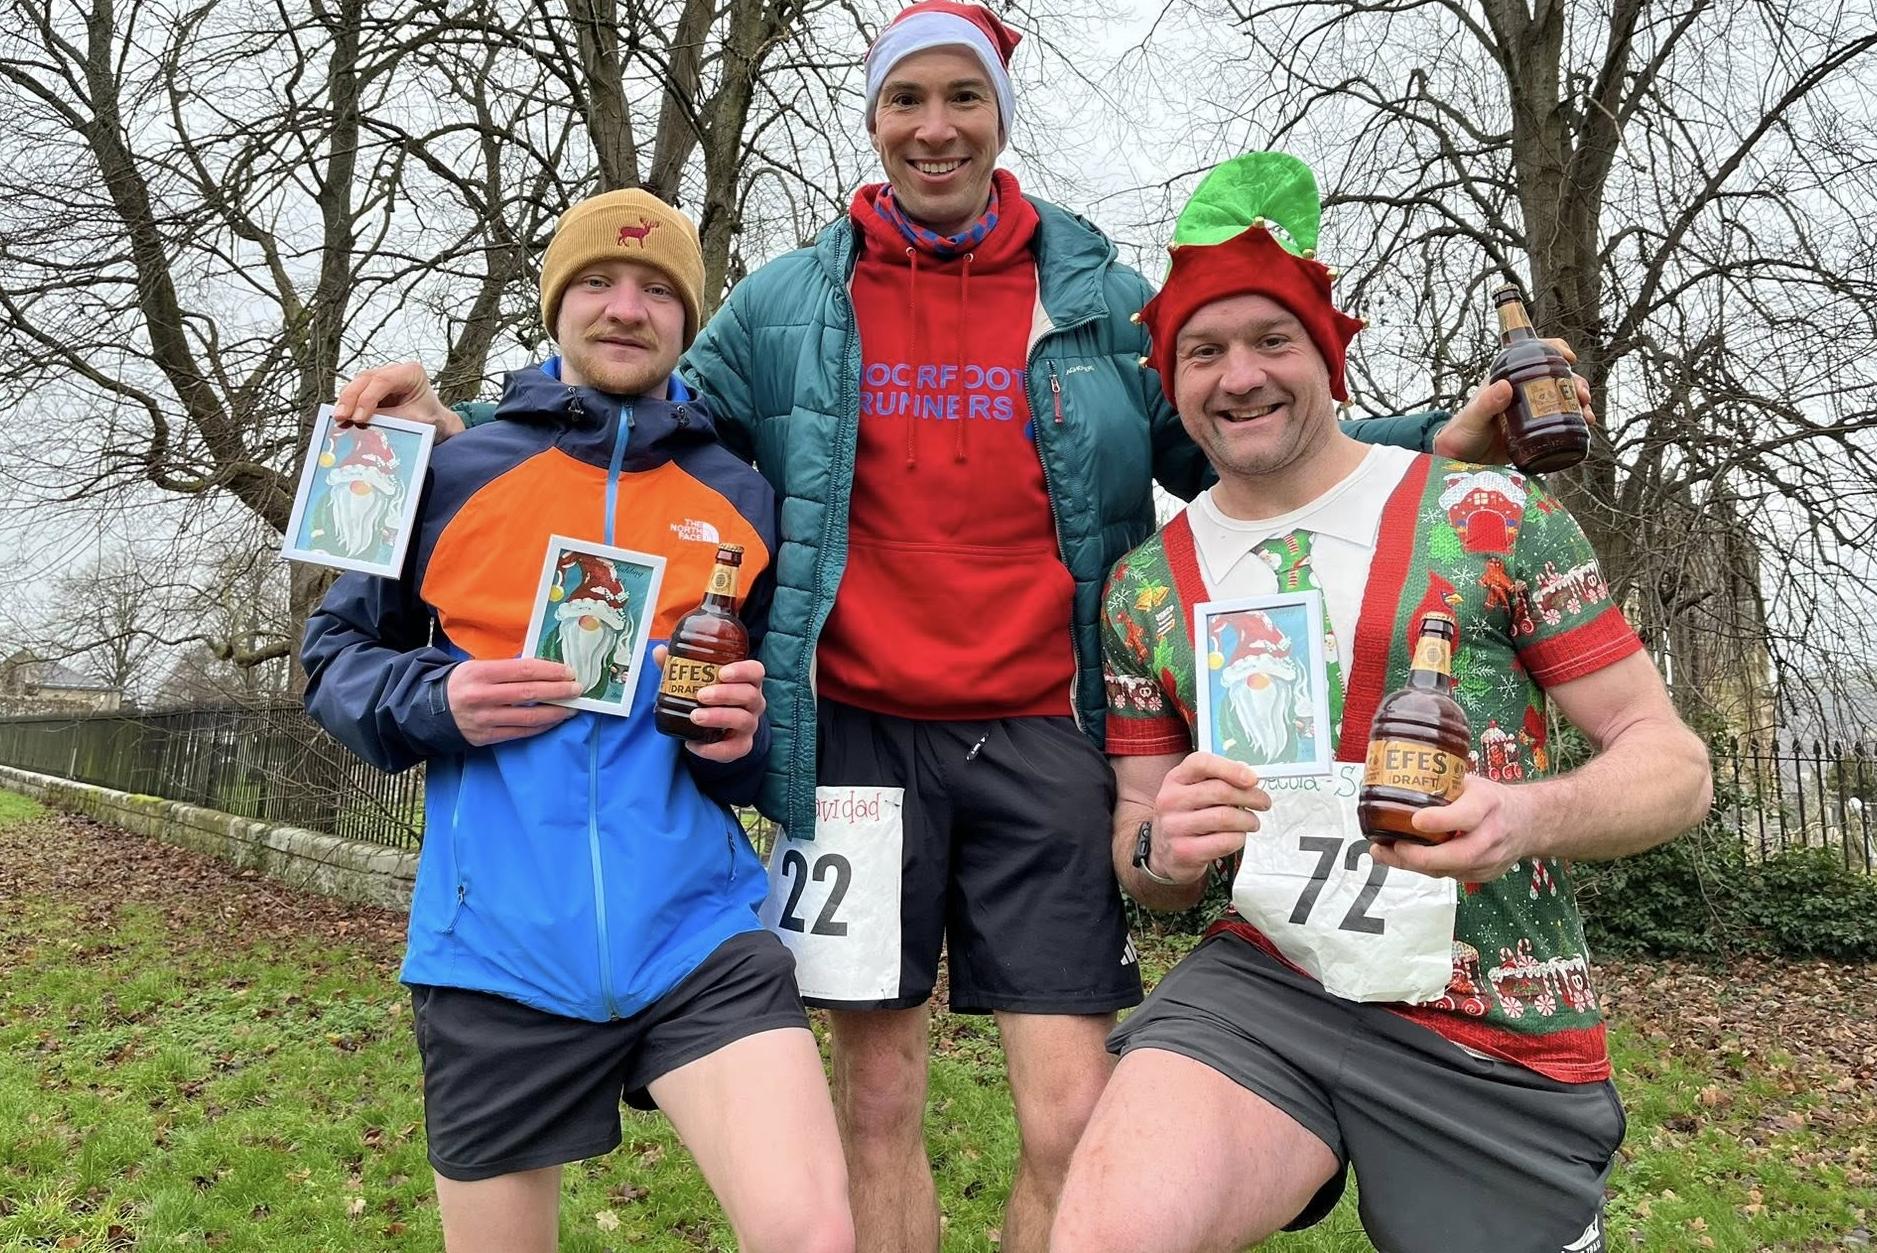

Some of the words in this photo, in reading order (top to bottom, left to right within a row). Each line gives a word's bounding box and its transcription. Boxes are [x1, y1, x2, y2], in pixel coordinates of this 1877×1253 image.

[861, 363, 1024, 392] OORFOOT
[861, 391, 1013, 420] RUNNERS
[671, 523, 703, 535] NORTH
[684, 518, 703, 529] THE
[679, 530, 703, 541] FACE
[668, 663, 715, 683] EFES
[671, 685, 703, 694] DRAF
[1386, 749, 1447, 775] EFES
[1392, 774, 1438, 788] DRAFT
[779, 849, 852, 937] 22
[1288, 836, 1389, 935] 72
